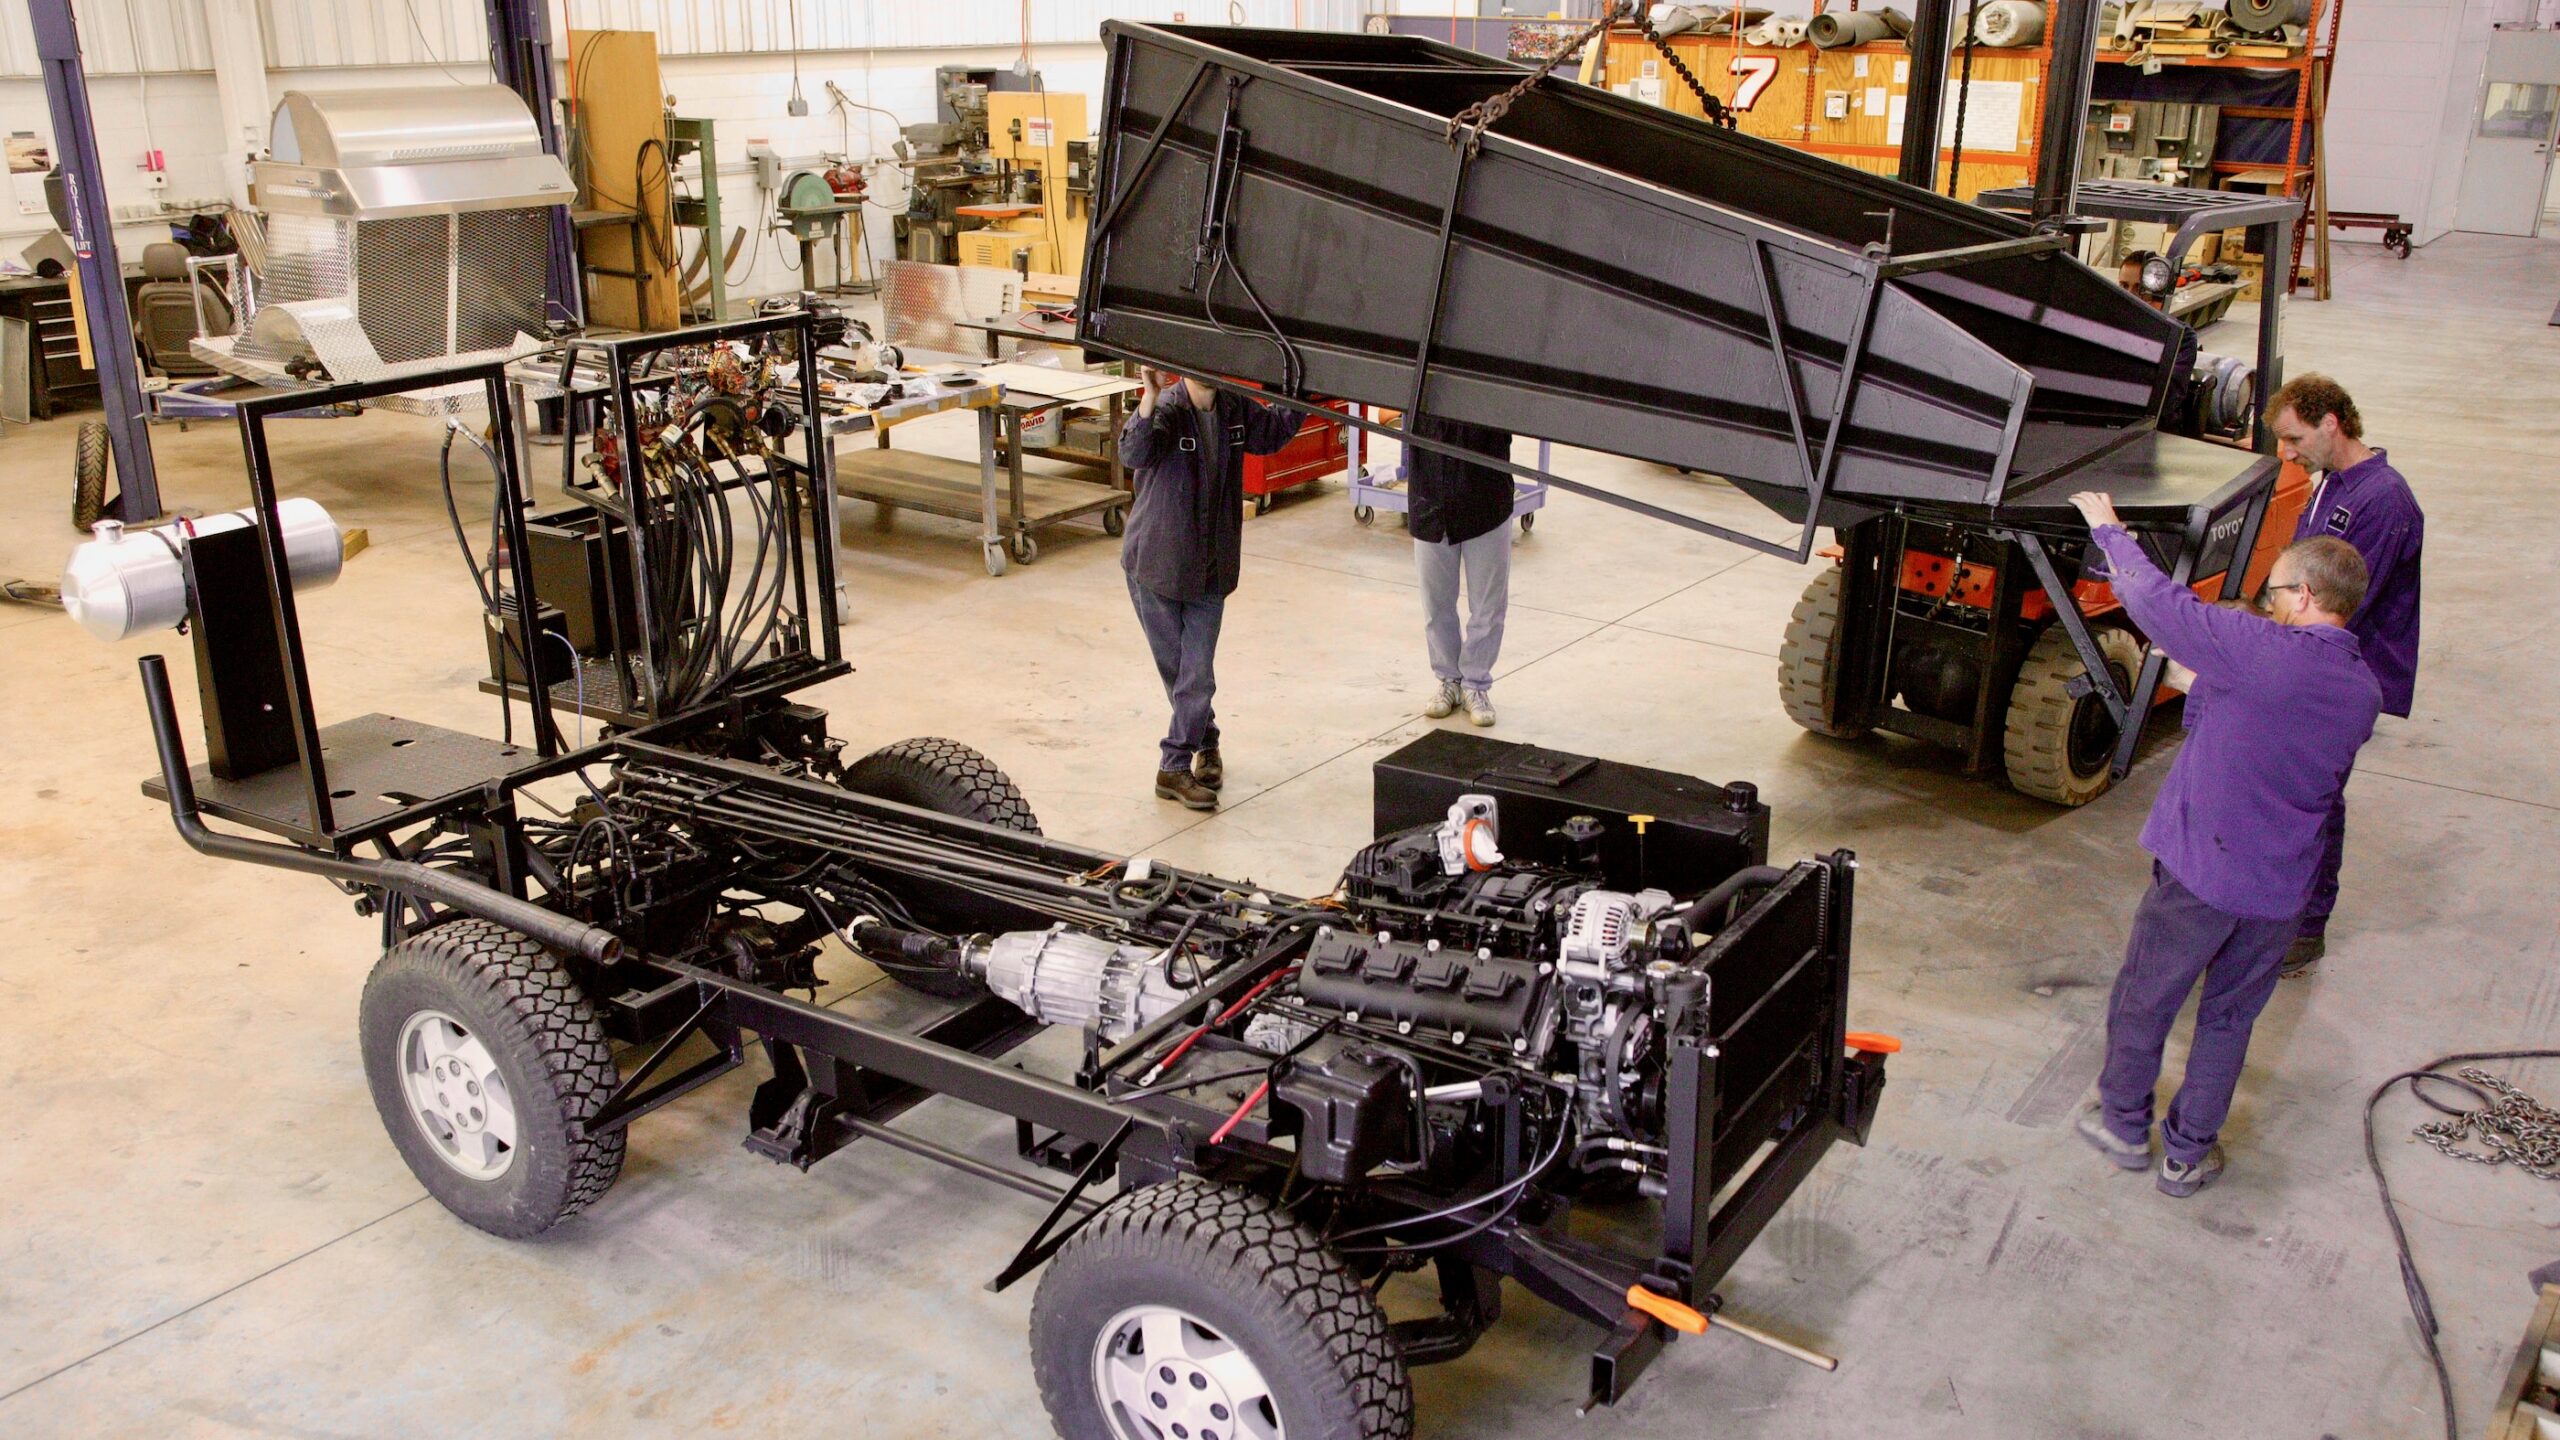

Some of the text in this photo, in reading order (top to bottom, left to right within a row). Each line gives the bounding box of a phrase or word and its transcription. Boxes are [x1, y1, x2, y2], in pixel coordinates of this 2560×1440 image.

[1728, 55, 1779, 112] 7
[68, 173, 84, 241] ROTARY
[76, 241, 91, 251] LIFT
[2210, 516, 2244, 542] TOYOT
